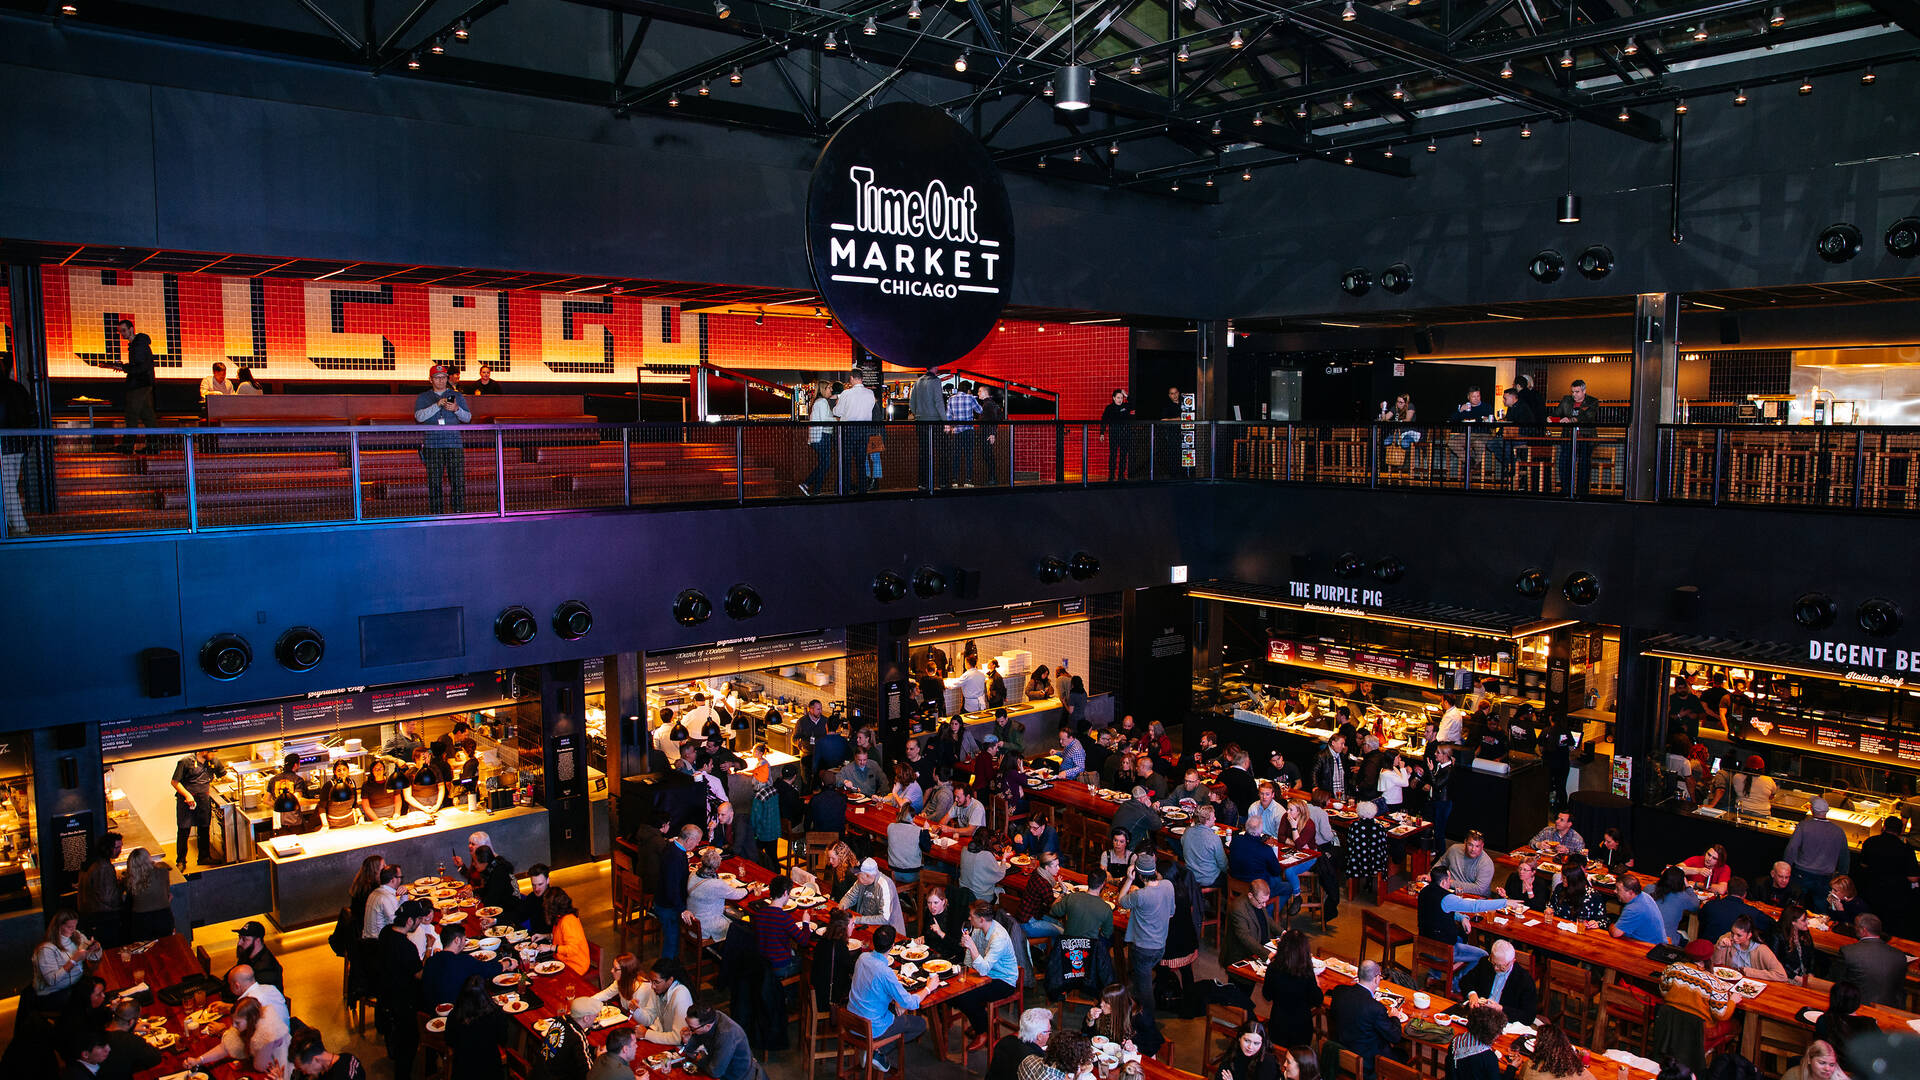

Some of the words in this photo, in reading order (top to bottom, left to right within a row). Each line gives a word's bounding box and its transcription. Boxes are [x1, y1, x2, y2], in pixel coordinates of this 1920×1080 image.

[850, 165, 924, 237] Time
[925, 179, 978, 243] Out
[830, 237, 999, 280] MARKET
[880, 278, 957, 298] CHICAGO
[0, 265, 708, 376] HICAGO
[1289, 581, 1310, 598] THE
[1314, 583, 1358, 604] PURPLE
[1362, 589, 1383, 607] PIG
[1334, 606, 1366, 616] Sandwiches
[1809, 639, 1887, 668] DECENT
[1845, 671, 1879, 683] Italian
[1880, 674, 1905, 688] Beef
